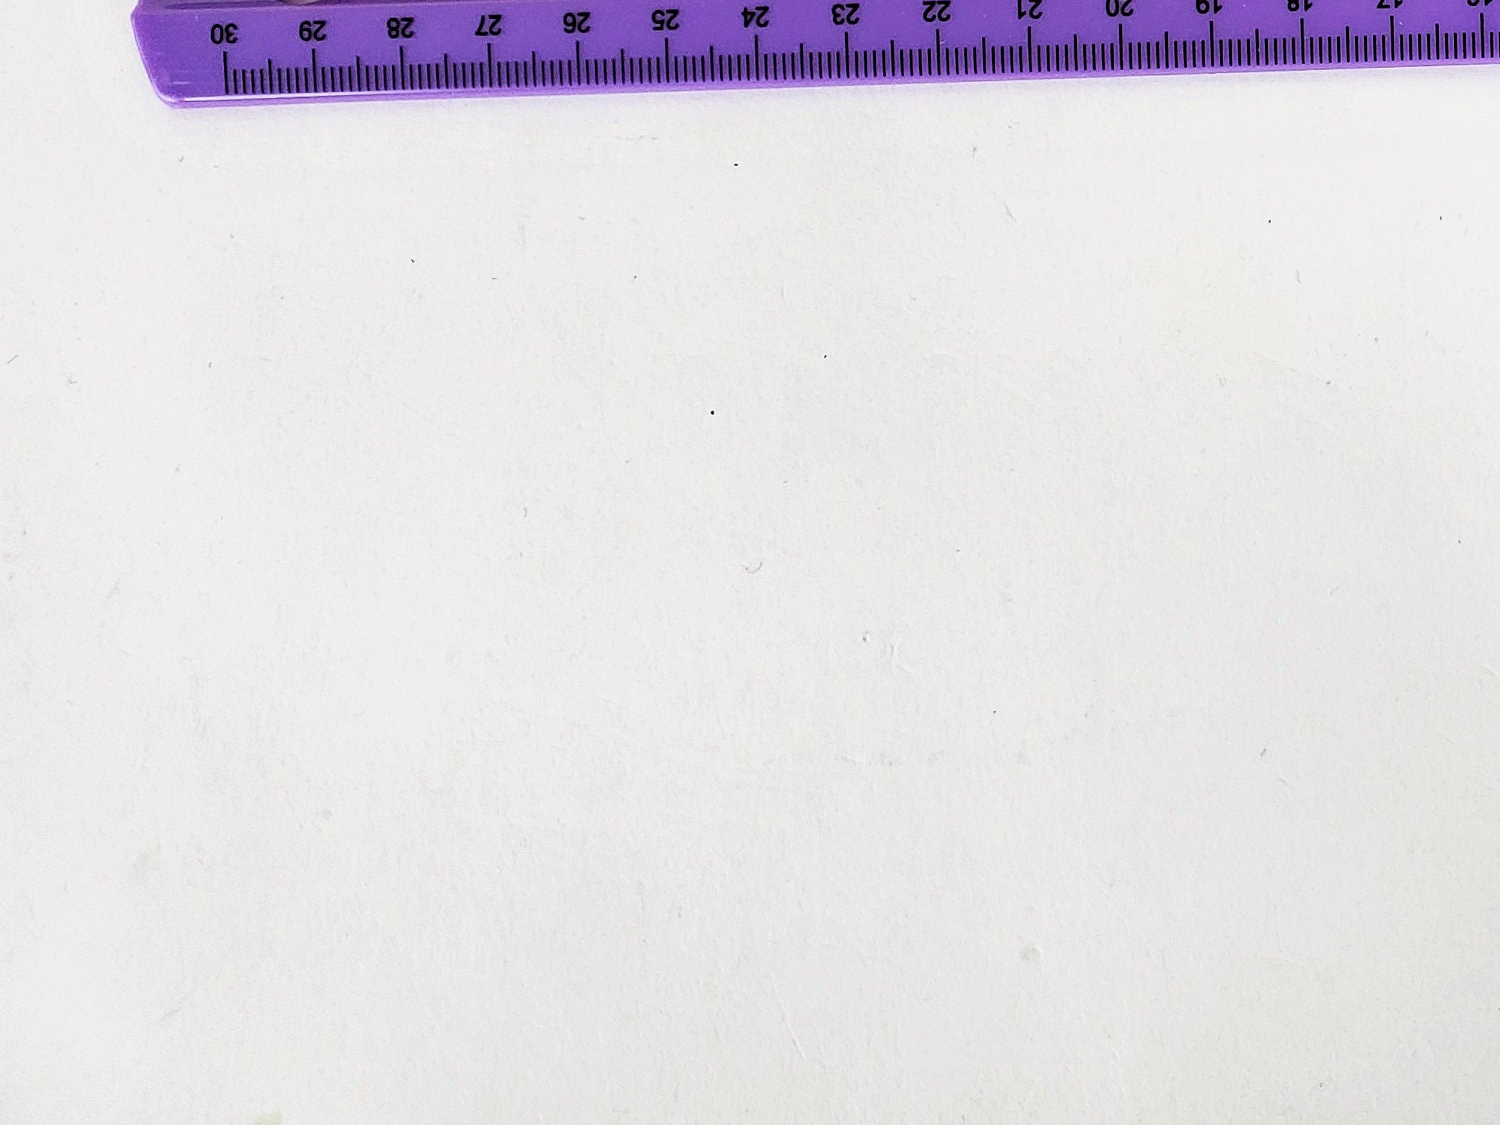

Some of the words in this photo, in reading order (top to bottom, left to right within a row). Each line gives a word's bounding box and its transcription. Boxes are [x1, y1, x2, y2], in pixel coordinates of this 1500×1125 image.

[210, 22, 239, 45] 30
[298, 19, 328, 43] 29
[386, 16, 416, 40] 28
[474, 13, 503, 37] 27
[562, 11, 592, 34] 26
[651, 8, 681, 32] 25
[740, 5, 771, 29] 24
[830, 2, 861, 26] 23
[922, 0, 952, 23] 22
